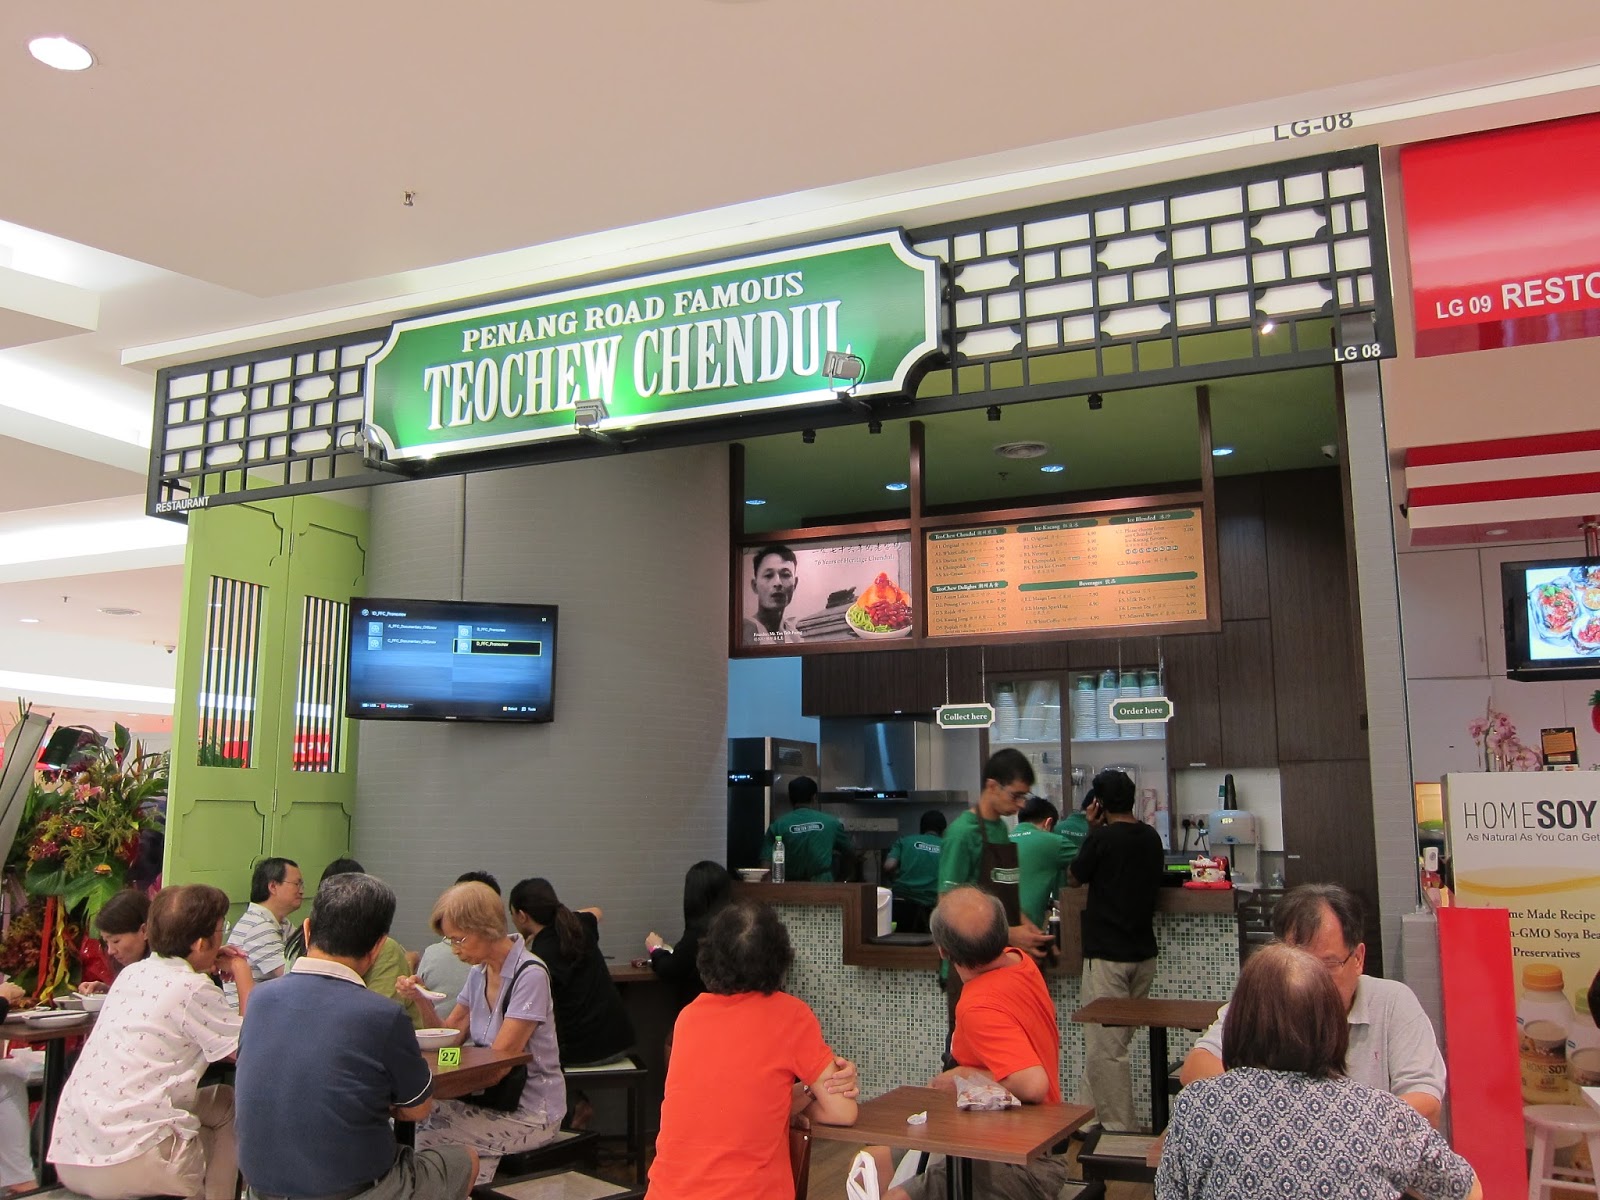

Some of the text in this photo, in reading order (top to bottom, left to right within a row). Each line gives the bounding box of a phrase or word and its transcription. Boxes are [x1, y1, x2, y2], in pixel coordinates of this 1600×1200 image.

[1274, 112, 1353, 141] LG-08
[1436, 272, 1600, 320] LG 09 RESTO
[463, 270, 804, 354] PENANG ROAD FAMOUS
[1333, 343, 1381, 362] LG 08
[424, 300, 851, 432] TEOCHEW CHENDUL
[156, 496, 210, 513] RESTAURANT
[1464, 800, 1598, 830] HOMESOY
[1482, 833, 1517, 841] Natural
[1520, 833, 1533, 841] As
[1536, 833, 1555, 841] You
[1558, 833, 1578, 841] Can
[1582, 833, 1600, 841] Get
[1527, 909, 1556, 919] Made
[1560, 910, 1596, 923] Recipe
[1510, 928, 1551, 938] n-GMO
[1554, 929, 1579, 941] Soya
[1513, 947, 1580, 958] Preservatives
[442, 1052, 456, 1061] 27
